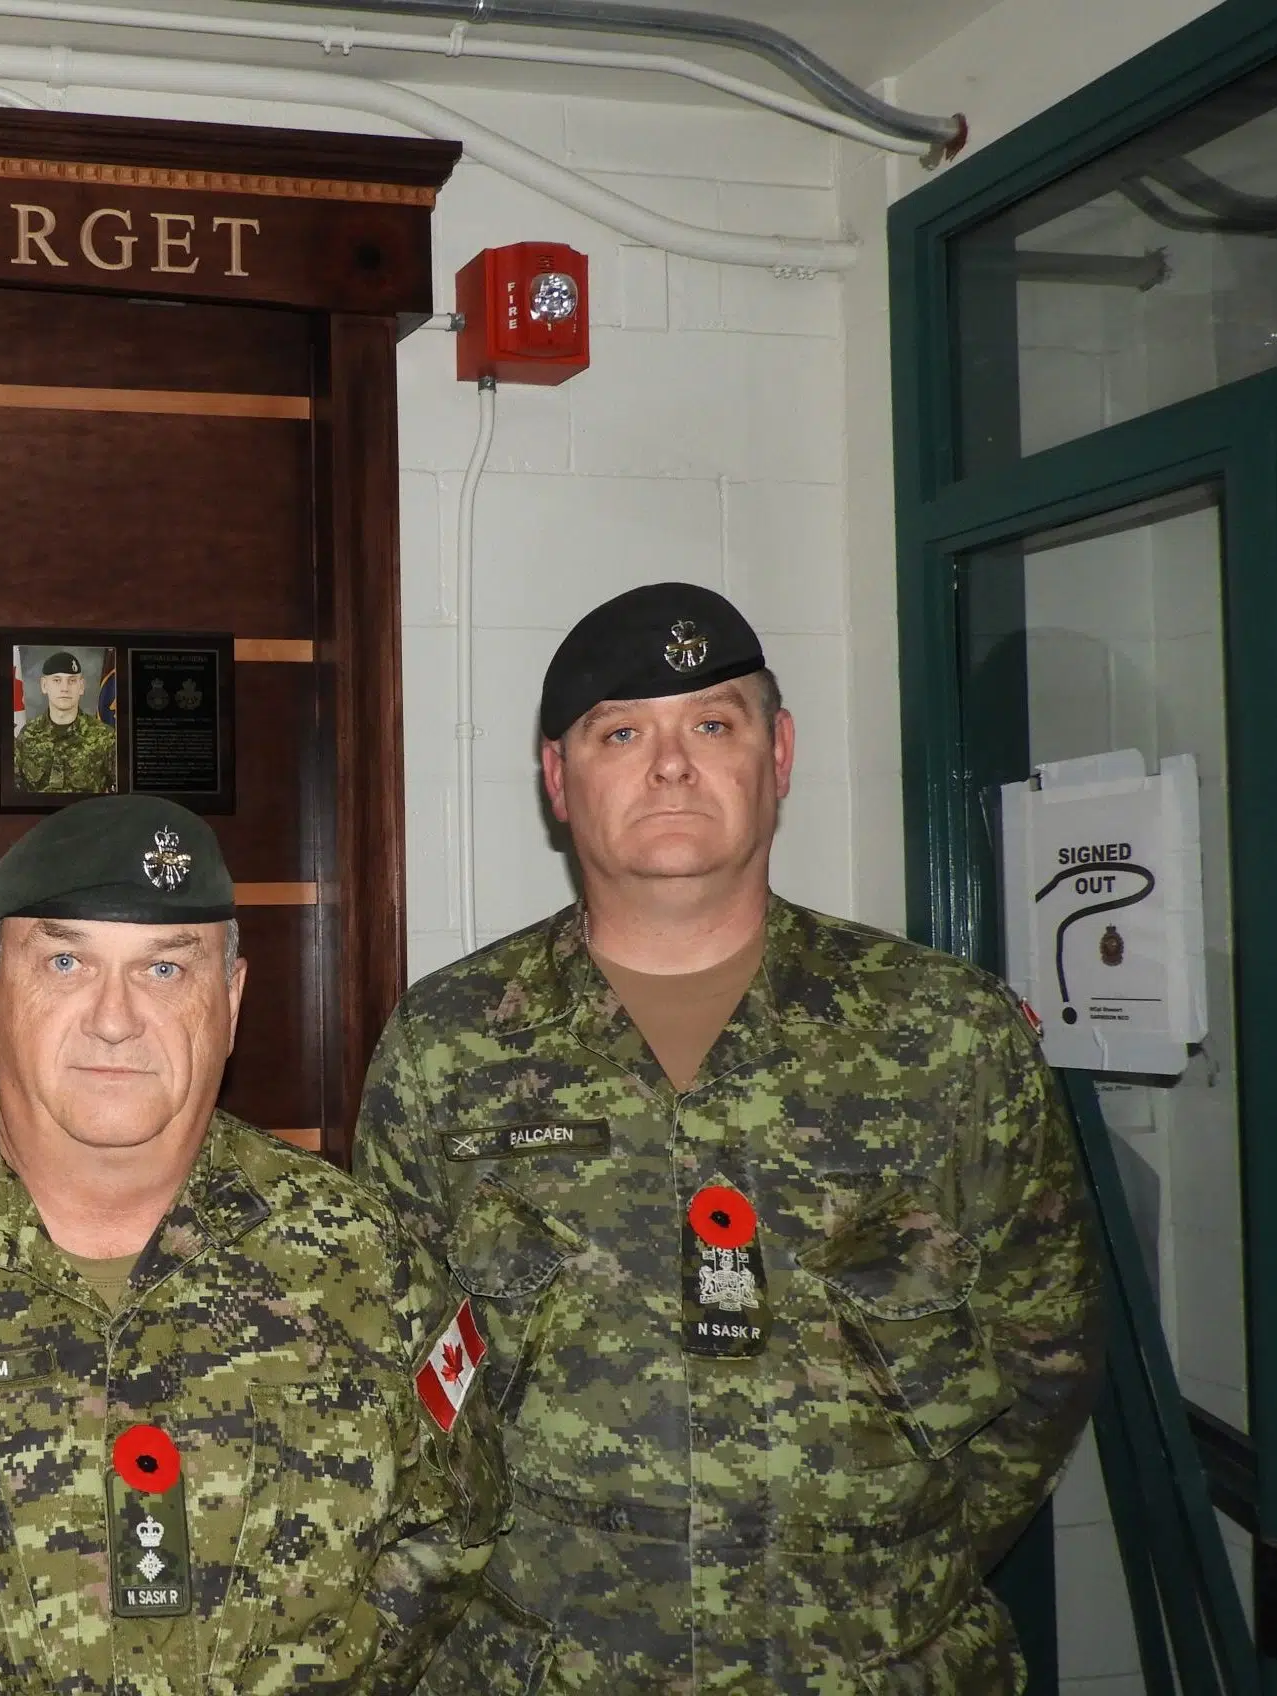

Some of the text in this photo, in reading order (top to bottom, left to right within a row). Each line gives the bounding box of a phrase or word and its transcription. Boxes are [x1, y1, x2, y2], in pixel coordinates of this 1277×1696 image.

[507, 281, 517, 330] FIRE
[1058, 842, 1132, 865] SIGNED
[1075, 875, 1116, 895] OUT
[698, 1322, 761, 1339] N SASK R
[127, 1590, 178, 1605] N SASK R
